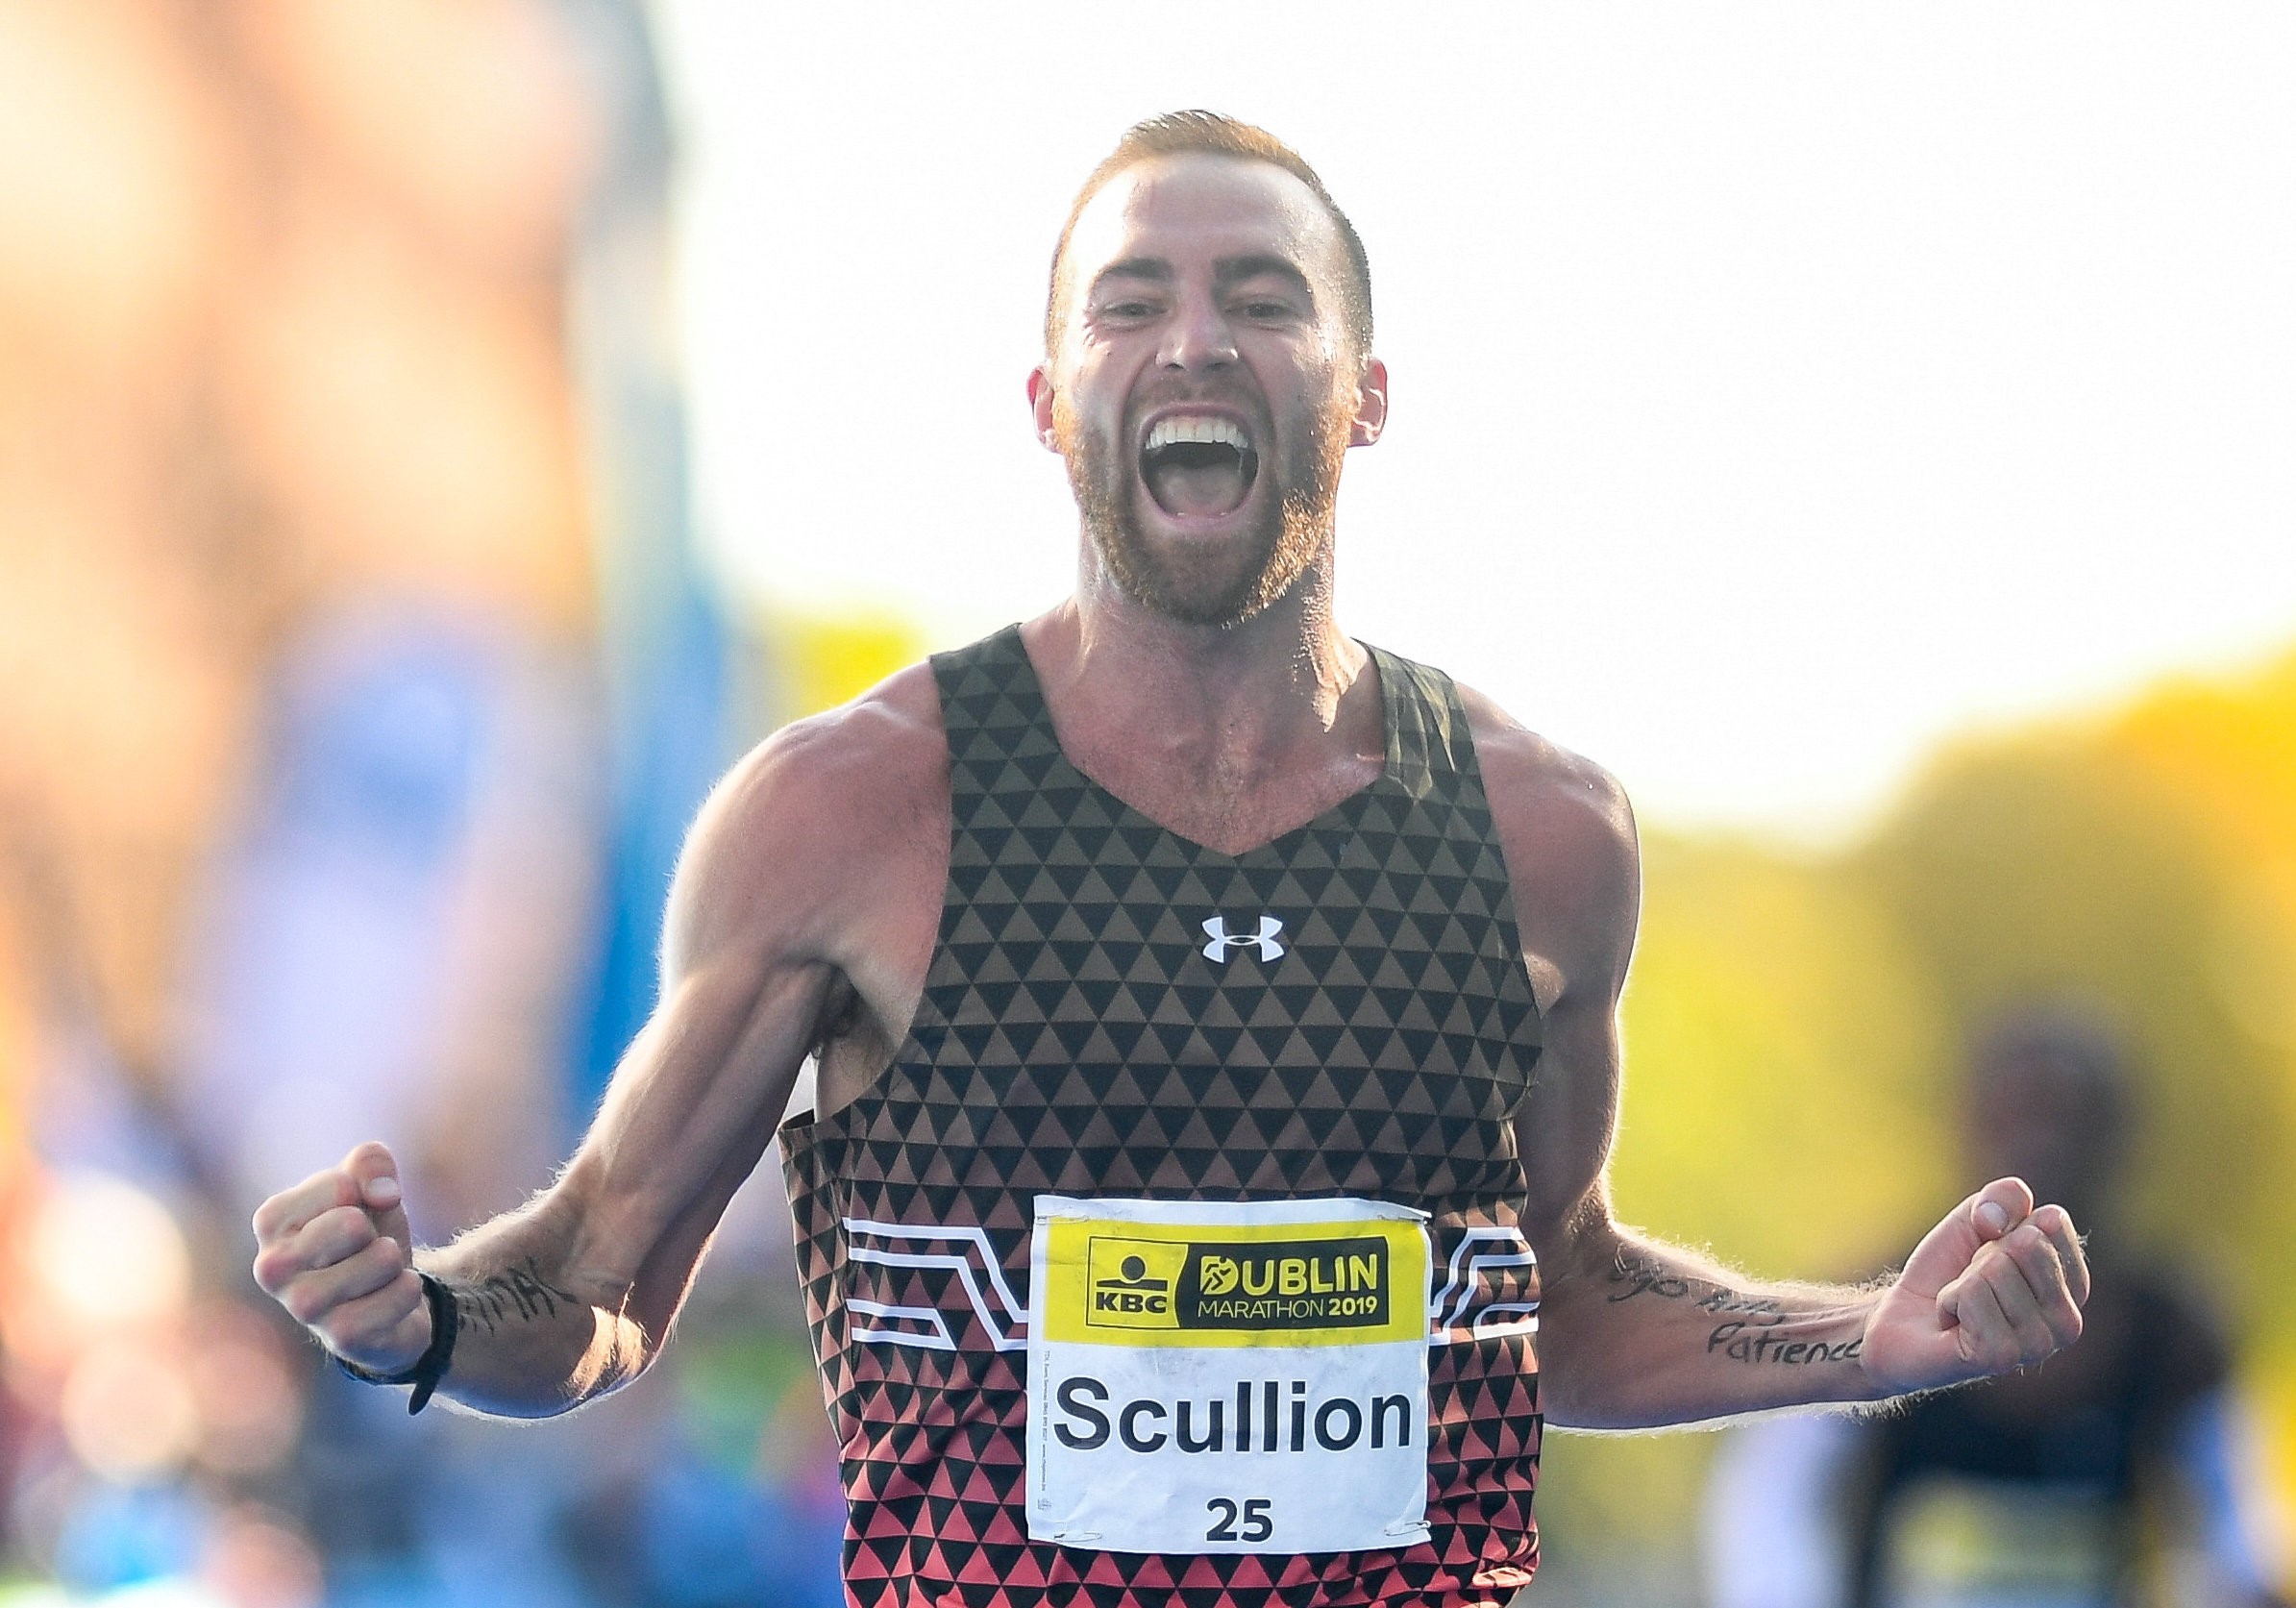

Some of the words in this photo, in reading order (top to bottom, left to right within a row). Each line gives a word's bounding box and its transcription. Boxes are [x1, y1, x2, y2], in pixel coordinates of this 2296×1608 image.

[1199, 1252, 1378, 1296] DUBLIN
[1095, 1291, 1168, 1315] KBC
[1197, 1297, 1324, 1320] MARATHON
[1327, 1295, 1378, 1317] 2019
[1053, 1376, 1412, 1453] Scullion
[1205, 1497, 1273, 1543] 25
